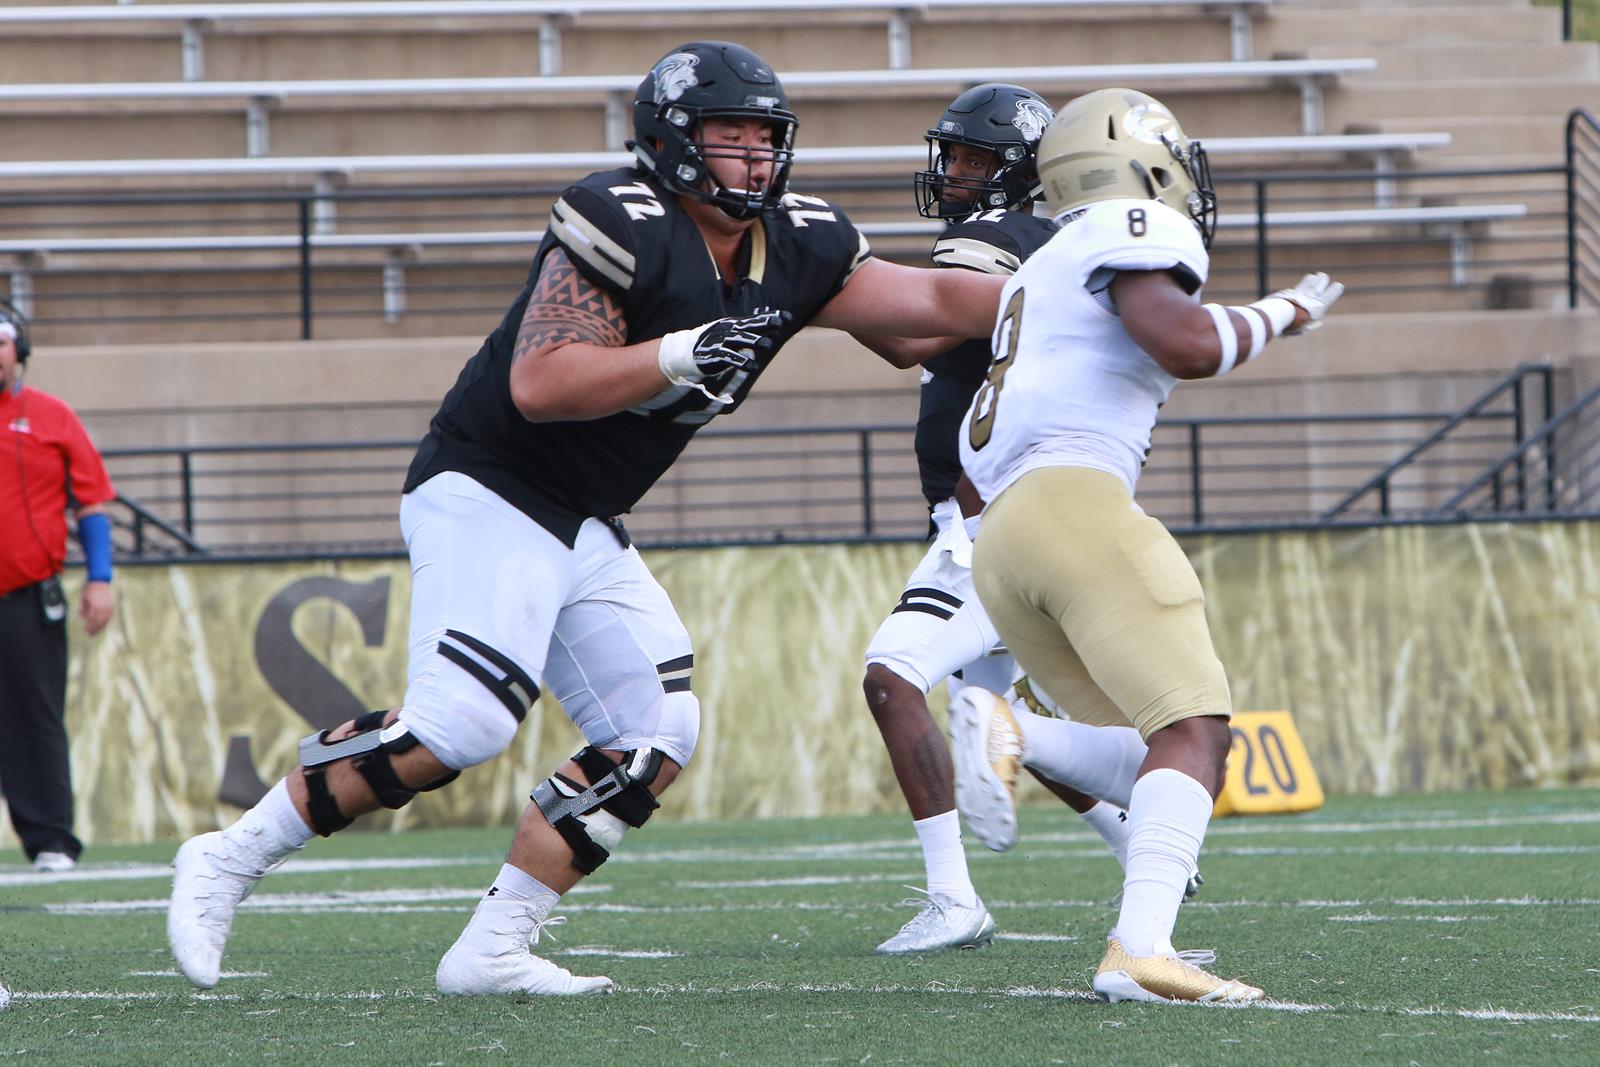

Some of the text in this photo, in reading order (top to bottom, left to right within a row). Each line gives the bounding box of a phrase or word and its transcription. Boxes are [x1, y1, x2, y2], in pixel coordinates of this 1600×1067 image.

[608, 181, 665, 221] 72
[1127, 208, 1147, 238] 8
[968, 285, 1025, 453] 8
[1231, 724, 1298, 796] 20
